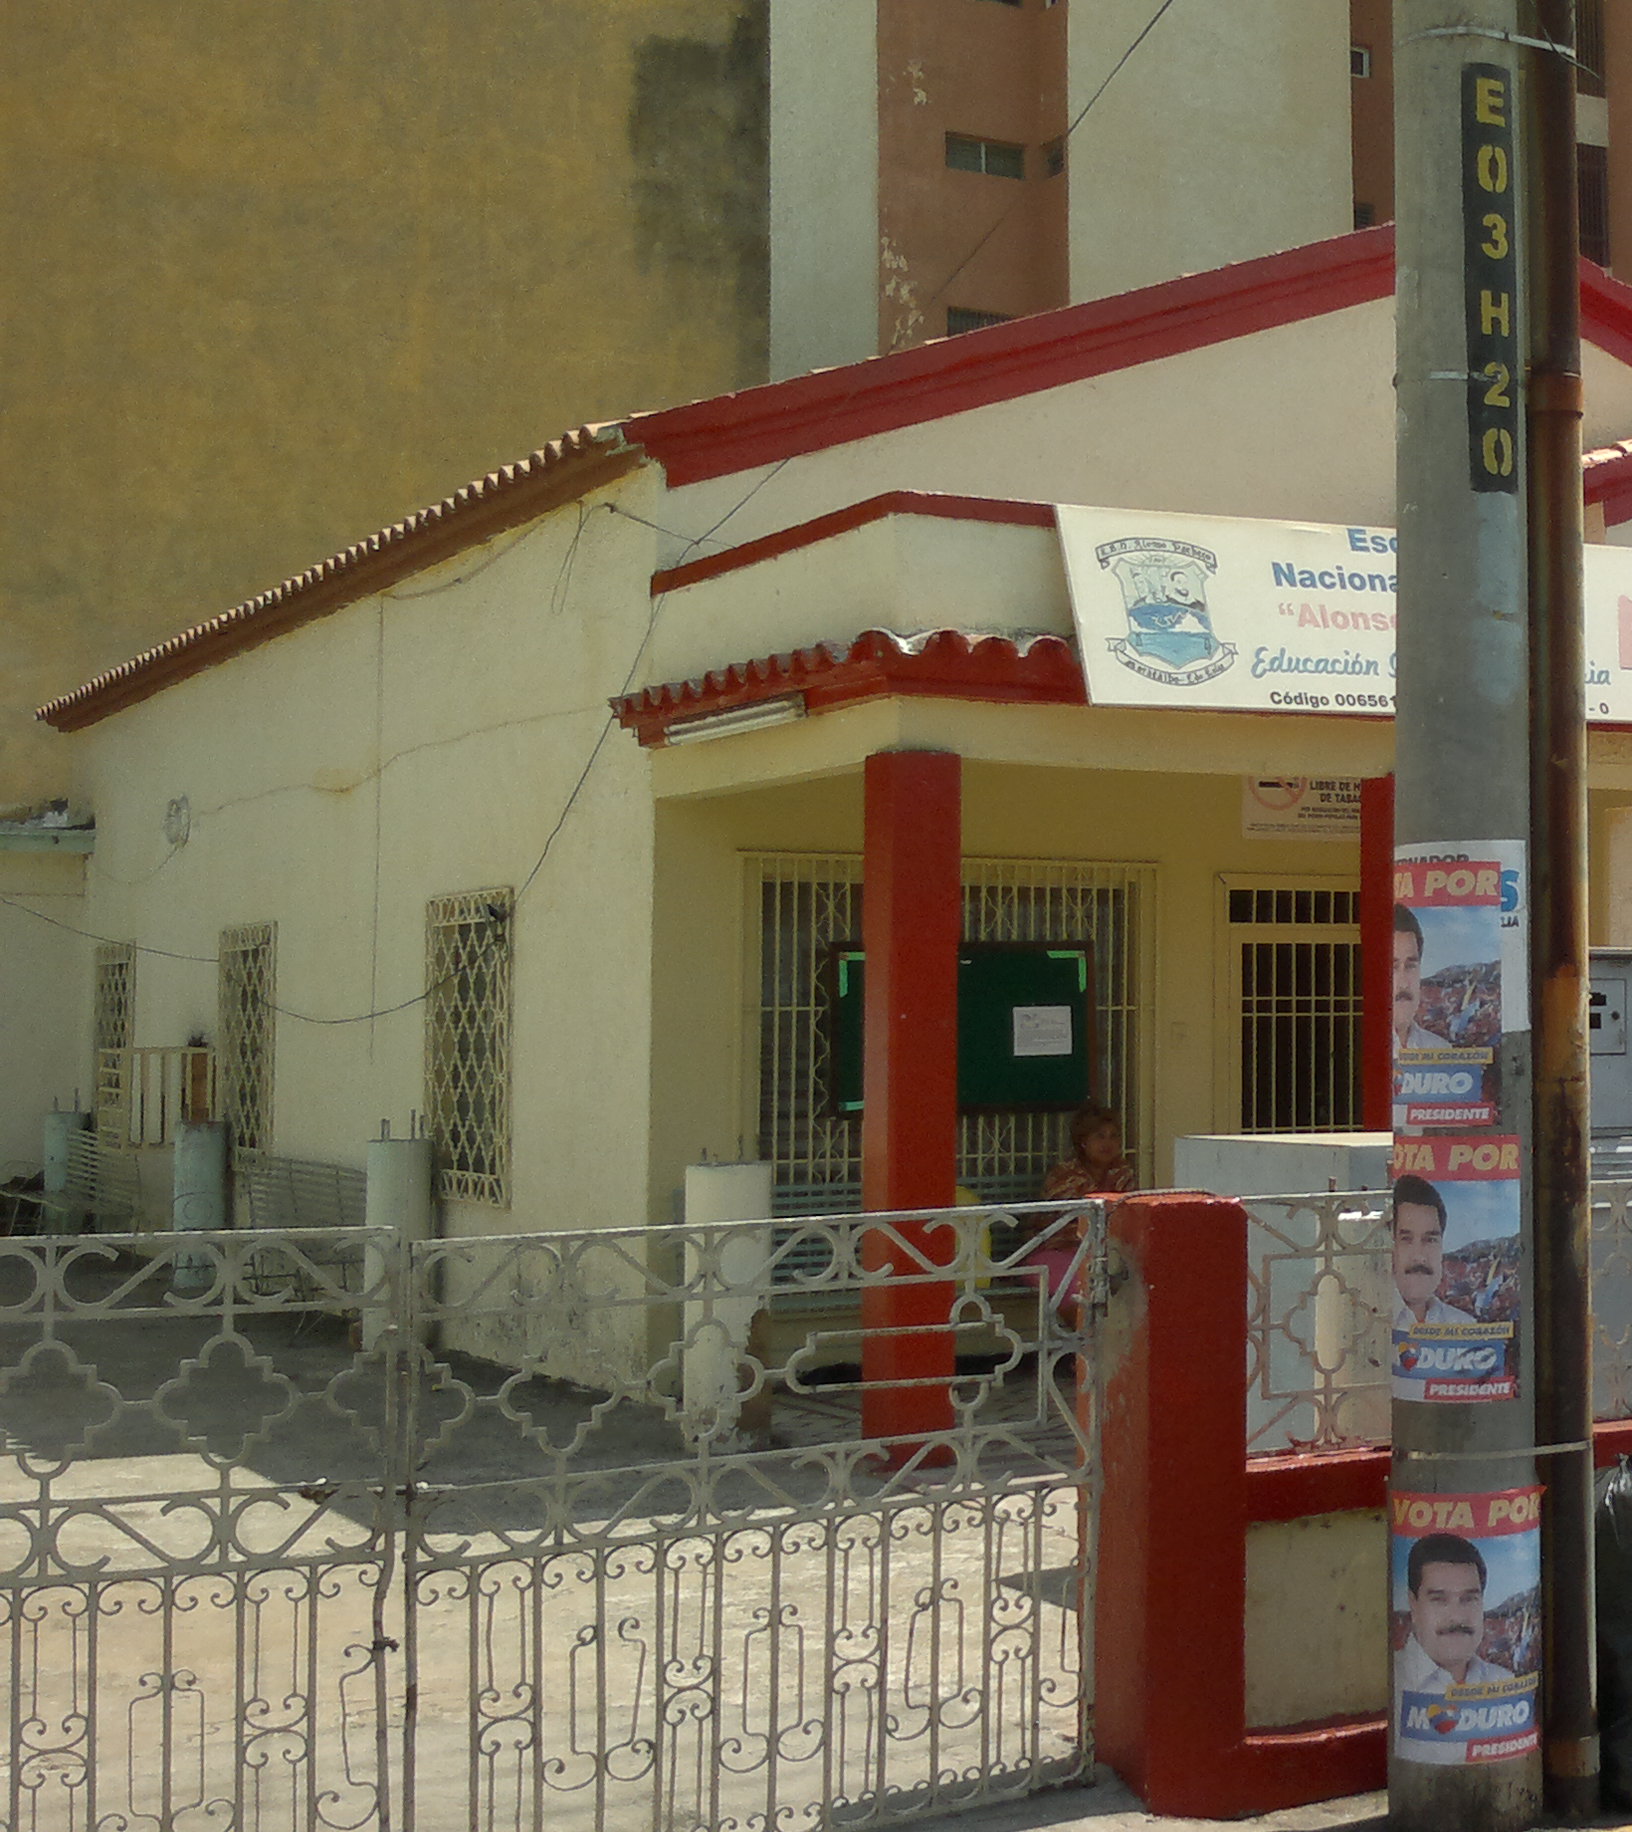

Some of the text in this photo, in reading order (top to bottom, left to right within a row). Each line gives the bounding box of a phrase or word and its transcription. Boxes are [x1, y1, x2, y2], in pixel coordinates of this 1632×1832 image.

[1251, 646, 1379, 680] Educación
[1585, 660, 1611, 685] ia
[1270, 691, 1330, 708] Código
[1309, 781, 1337, 791] LIBRE
[1339, 781, 1351, 791] DE
[1320, 793, 1332, 802] DE
[1424, 869, 1499, 898] POR
[1409, 1107, 1490, 1121] PRESIDENTE
[1447, 1143, 1519, 1171] POR
[1430, 1382, 1511, 1396] PRESIDENTE
[1394, 1498, 1475, 1529] VOTA
